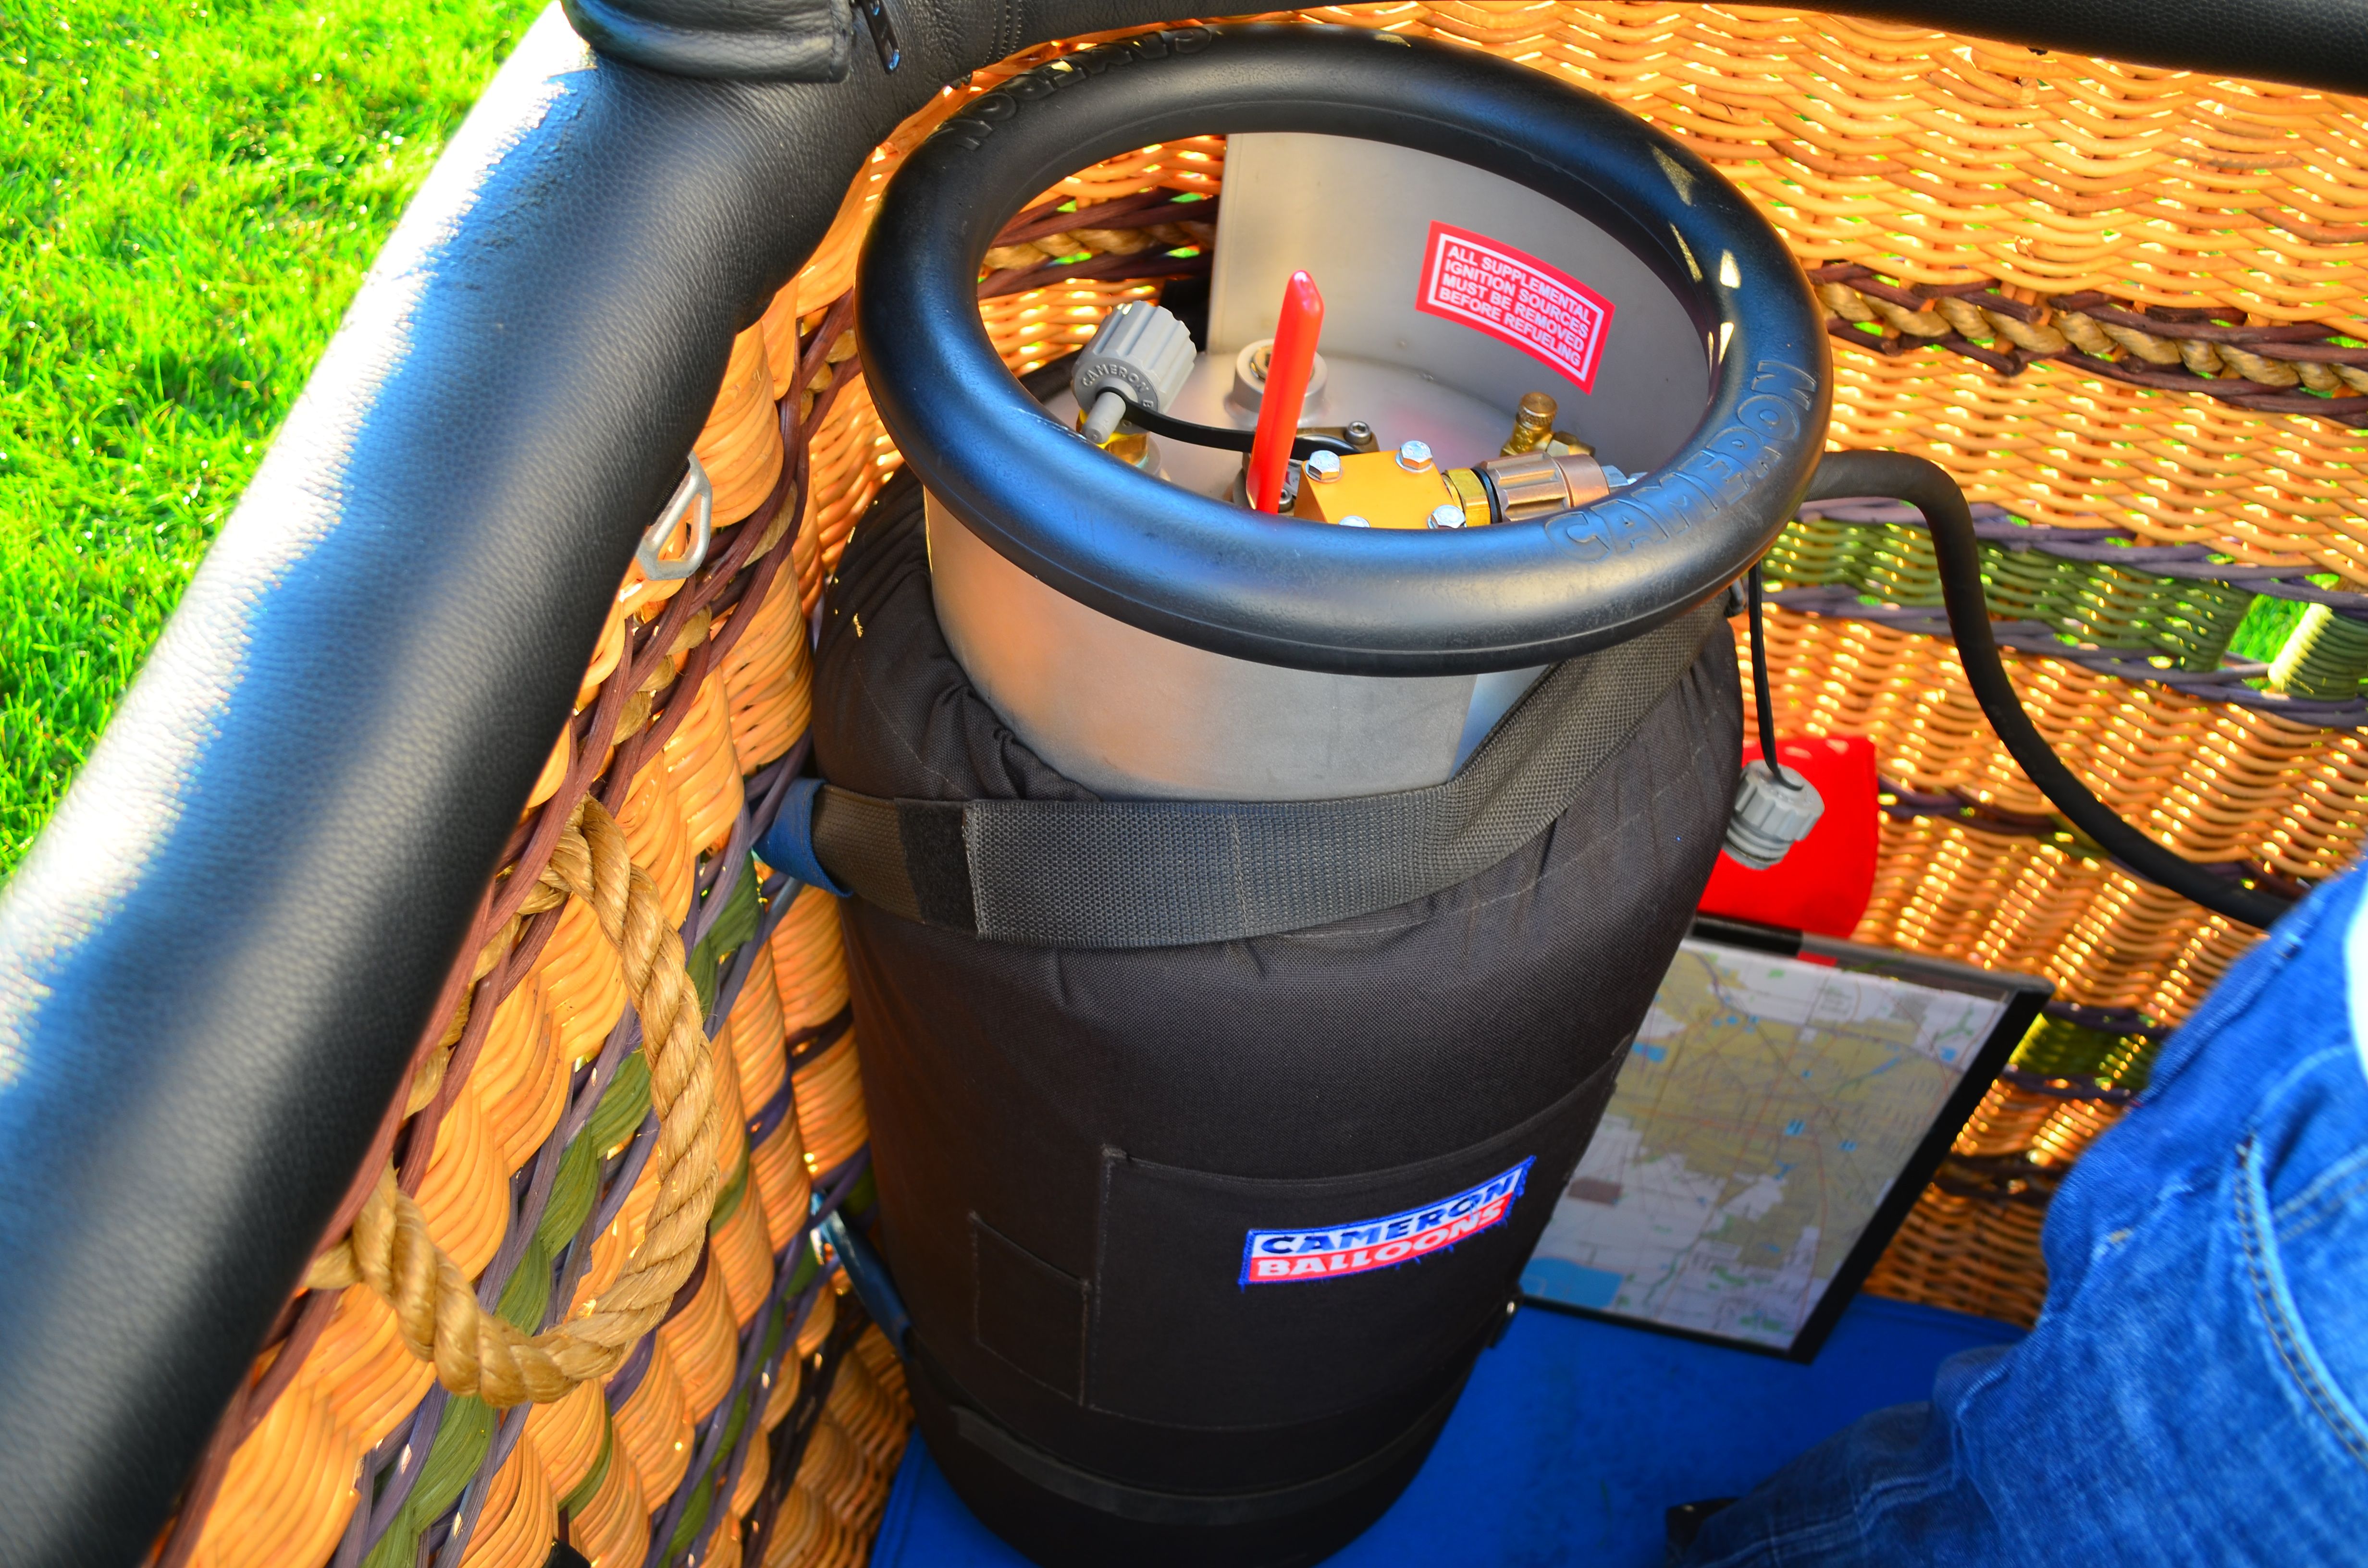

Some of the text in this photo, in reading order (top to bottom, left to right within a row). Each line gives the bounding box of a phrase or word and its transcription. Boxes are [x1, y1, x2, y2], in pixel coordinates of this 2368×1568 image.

[1443, 272, 1584, 352] MUST BE REMOVED
[1445, 258, 1589, 338] IGNITION SOURCES
[1447, 245, 1591, 325] ALL SUPPLEMENTAL
[1439, 287, 1581, 366] BEFORE REFUELING
[1082, 364, 1149, 392] CAMERON
[1545, 361, 1817, 563] CAMERON
[1258, 1199, 1505, 1276] BALLOONS
[1261, 1173, 1516, 1254] CAMERON
